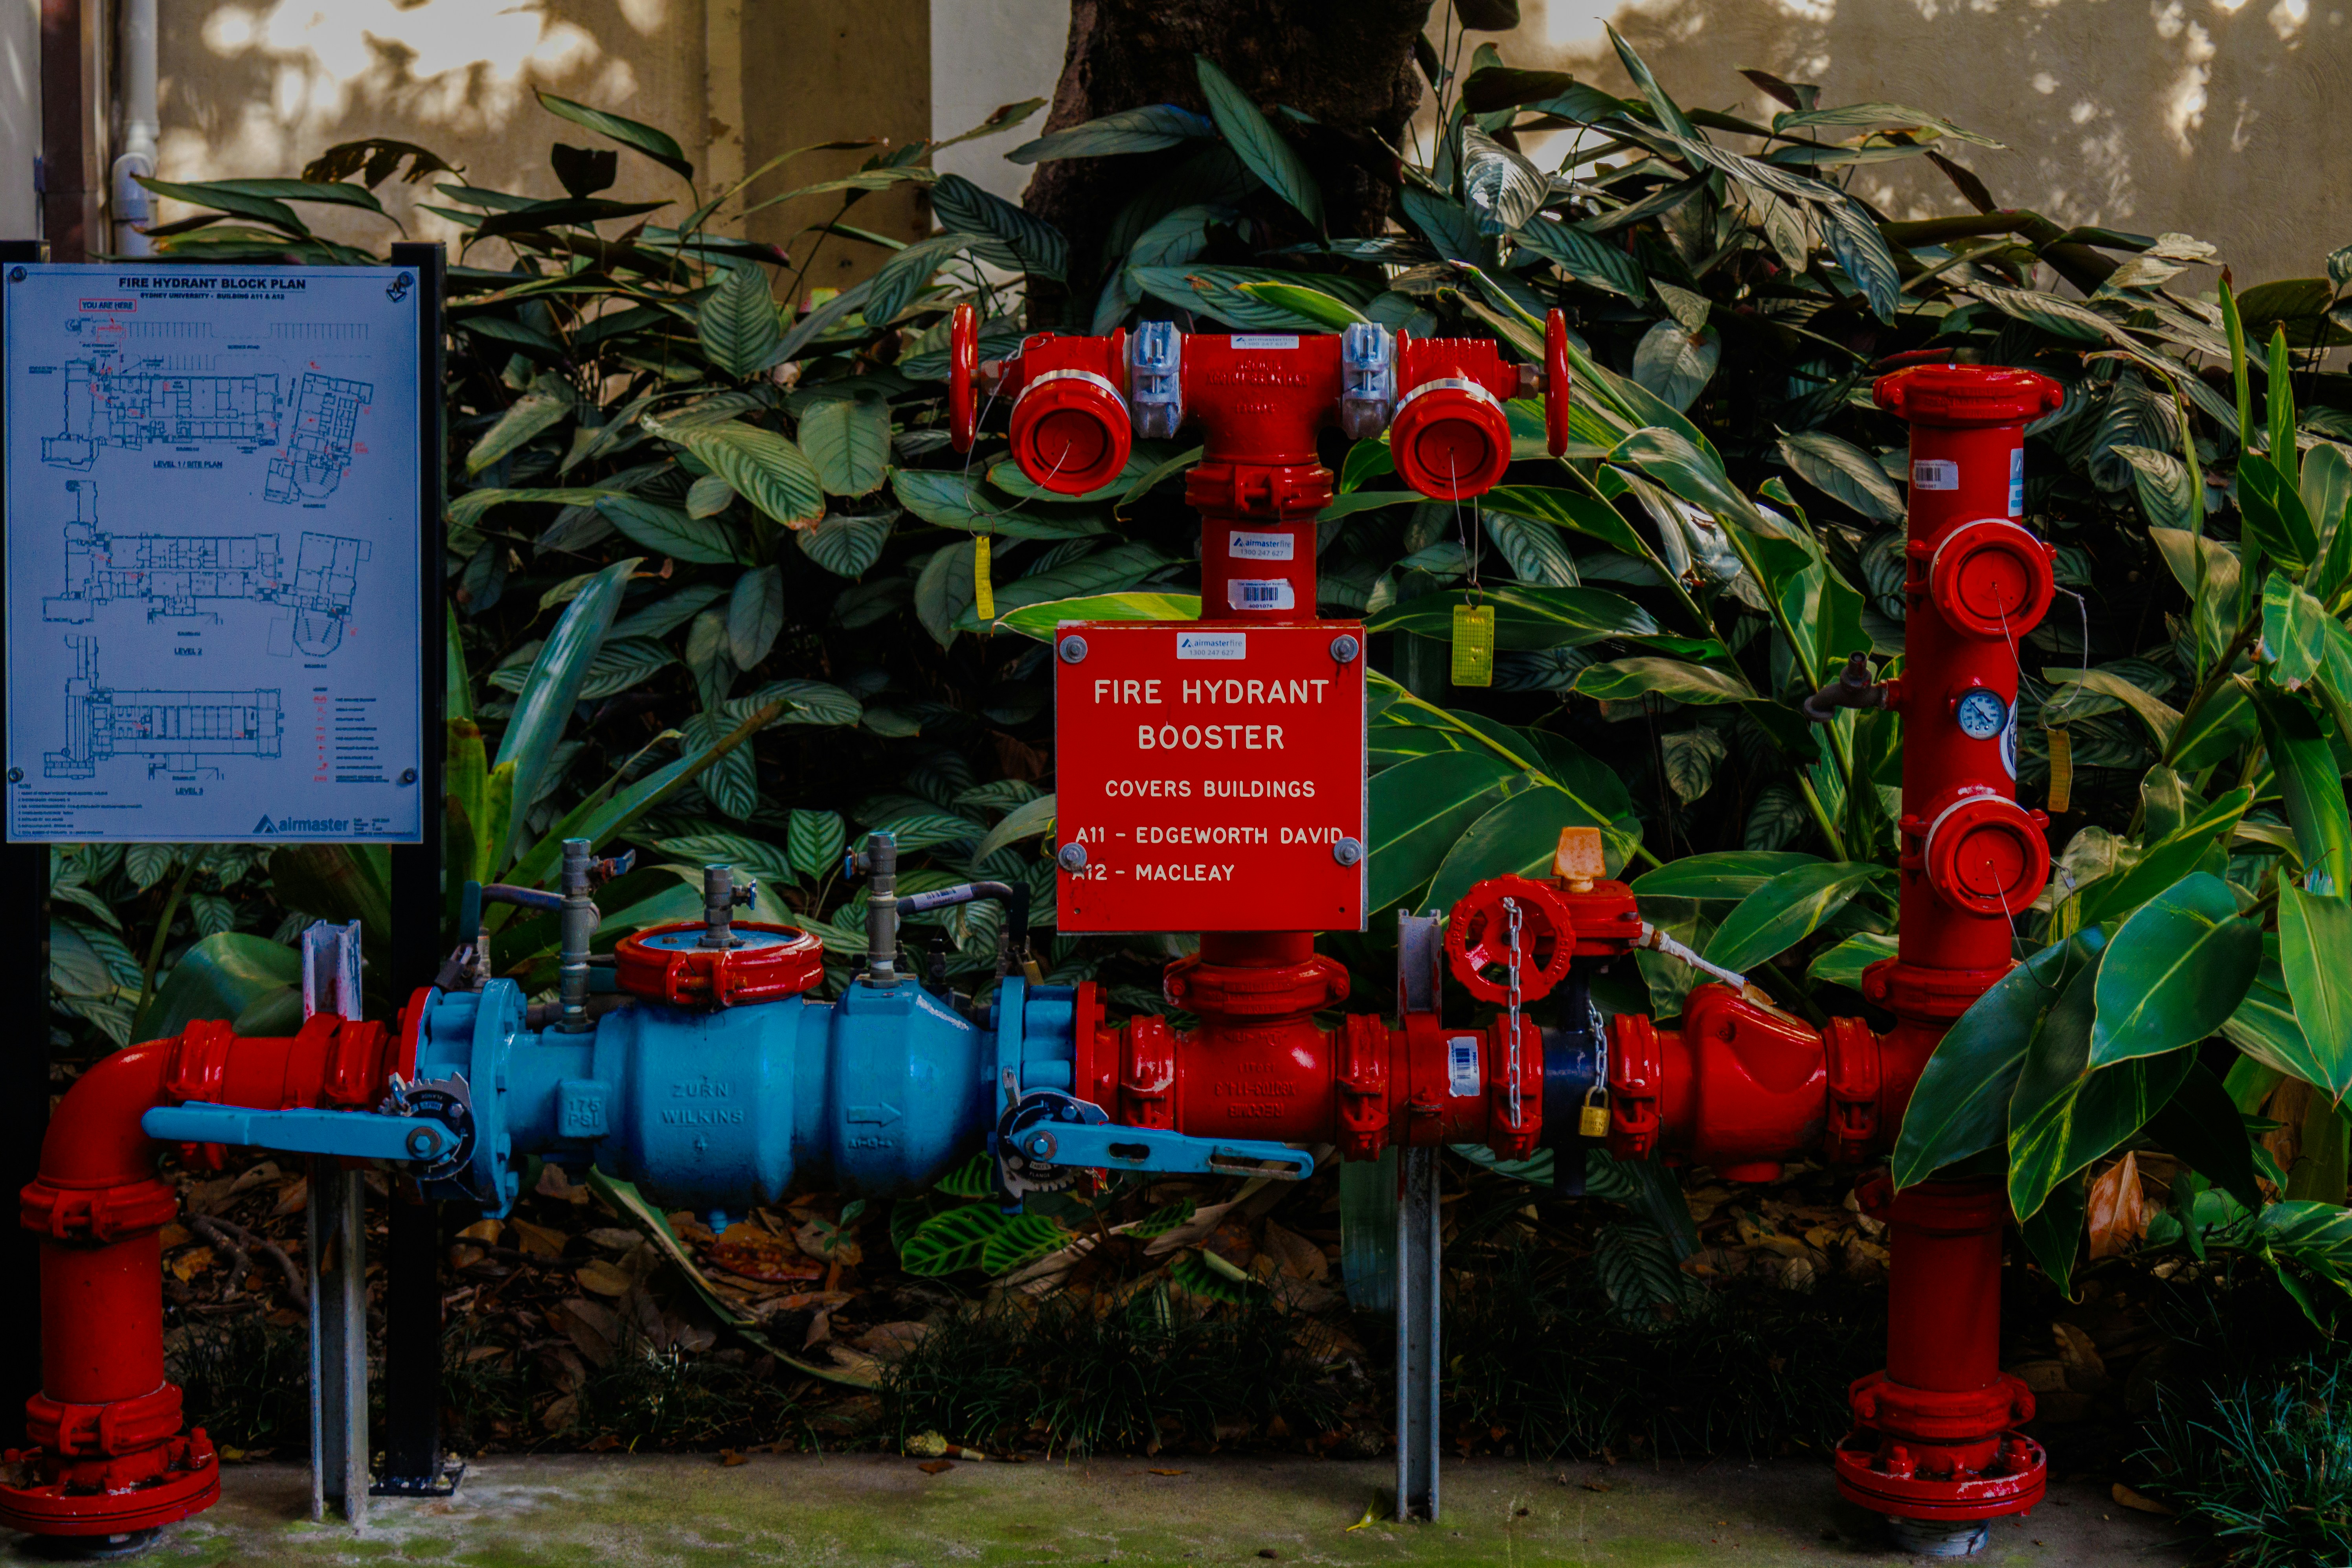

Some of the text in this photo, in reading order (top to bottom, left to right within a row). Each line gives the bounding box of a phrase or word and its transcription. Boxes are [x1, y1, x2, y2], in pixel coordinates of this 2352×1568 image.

[119, 278, 306, 289] FIRE HYDRANT BLOCK PLAN
[1245, 539, 1291, 548] airmasterfire
[1194, 639, 1242, 647] airmasterfire
[1095, 680, 1329, 704] FIRE HYDRANT
[1138, 725, 1284, 749] BOOSTER
[1105, 780, 1316, 798] COVERS BUILDINGS
[279, 816, 349, 832] airmaster
[1076, 827, 1105, 843] A11
[1136, 827, 1268, 844] EDGEWORTH
[1281, 827, 1344, 845] DAVID
[1136, 864, 1235, 881] MACLEAY
[672, 1083, 728, 1097] ZURN
[569, 1099, 602, 1112] 175
[1227, 1102, 1284, 1119] RECOMB
[568, 1114, 598, 1128] PSI
[662, 1110, 744, 1124] WILKINS
